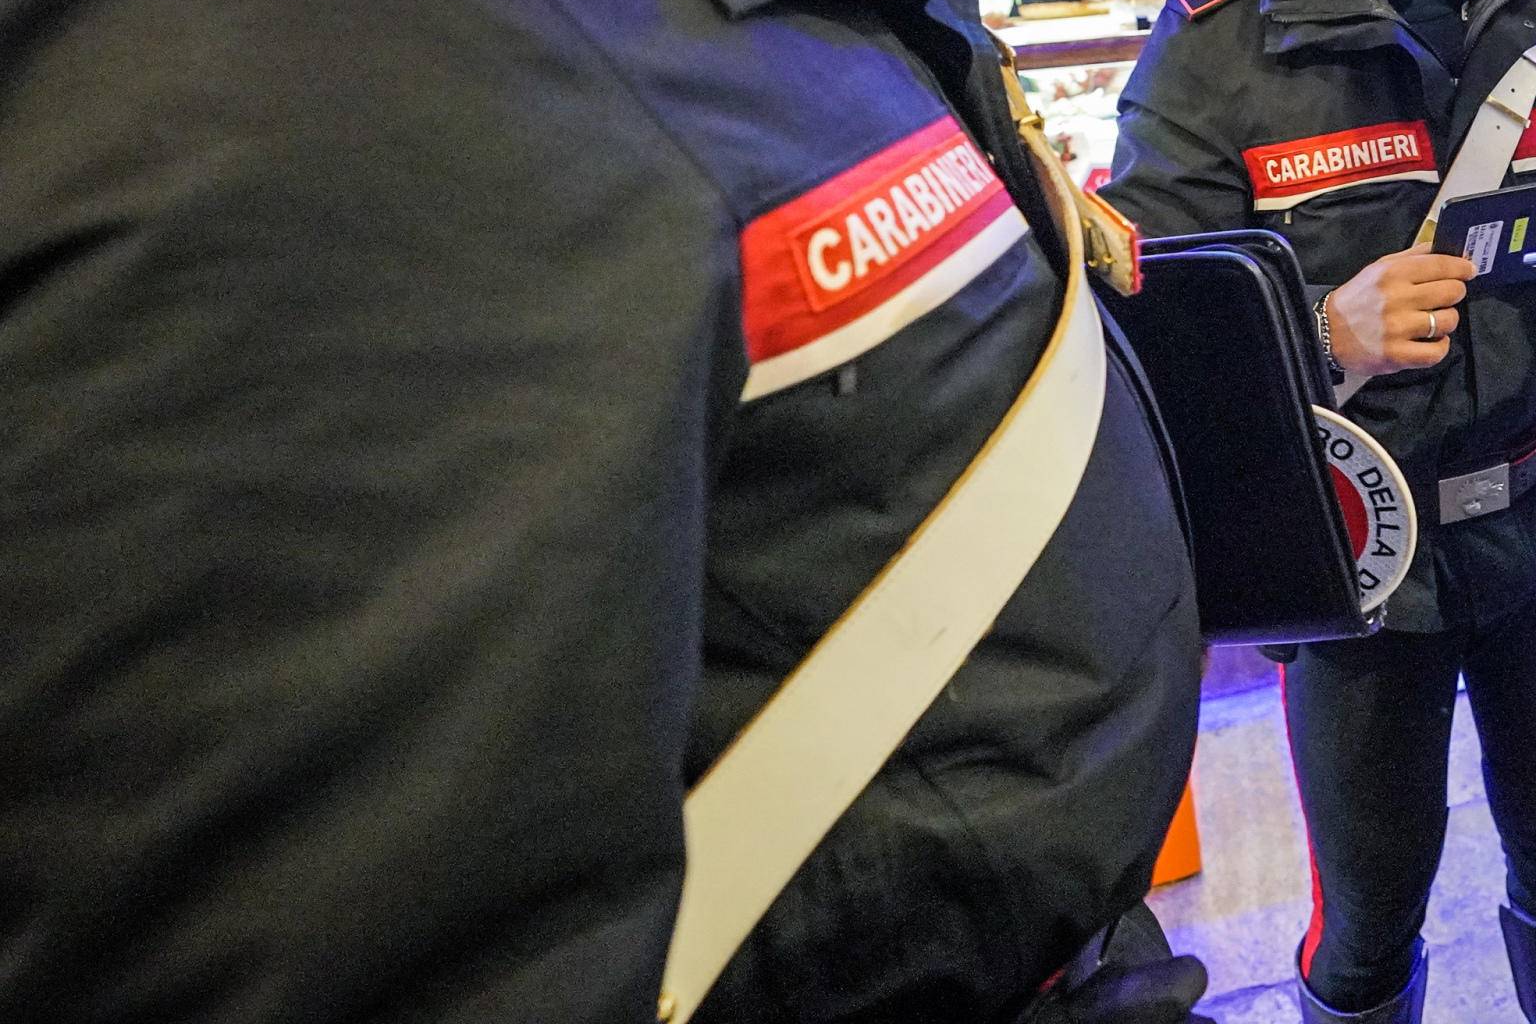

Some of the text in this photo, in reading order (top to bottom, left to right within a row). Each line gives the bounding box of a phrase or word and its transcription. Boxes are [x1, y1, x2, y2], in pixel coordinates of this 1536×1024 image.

[1266, 134, 1420, 184] CARABINIERI
[807, 140, 996, 292] CARABINIERI
[1357, 466, 1401, 558] DELLA
